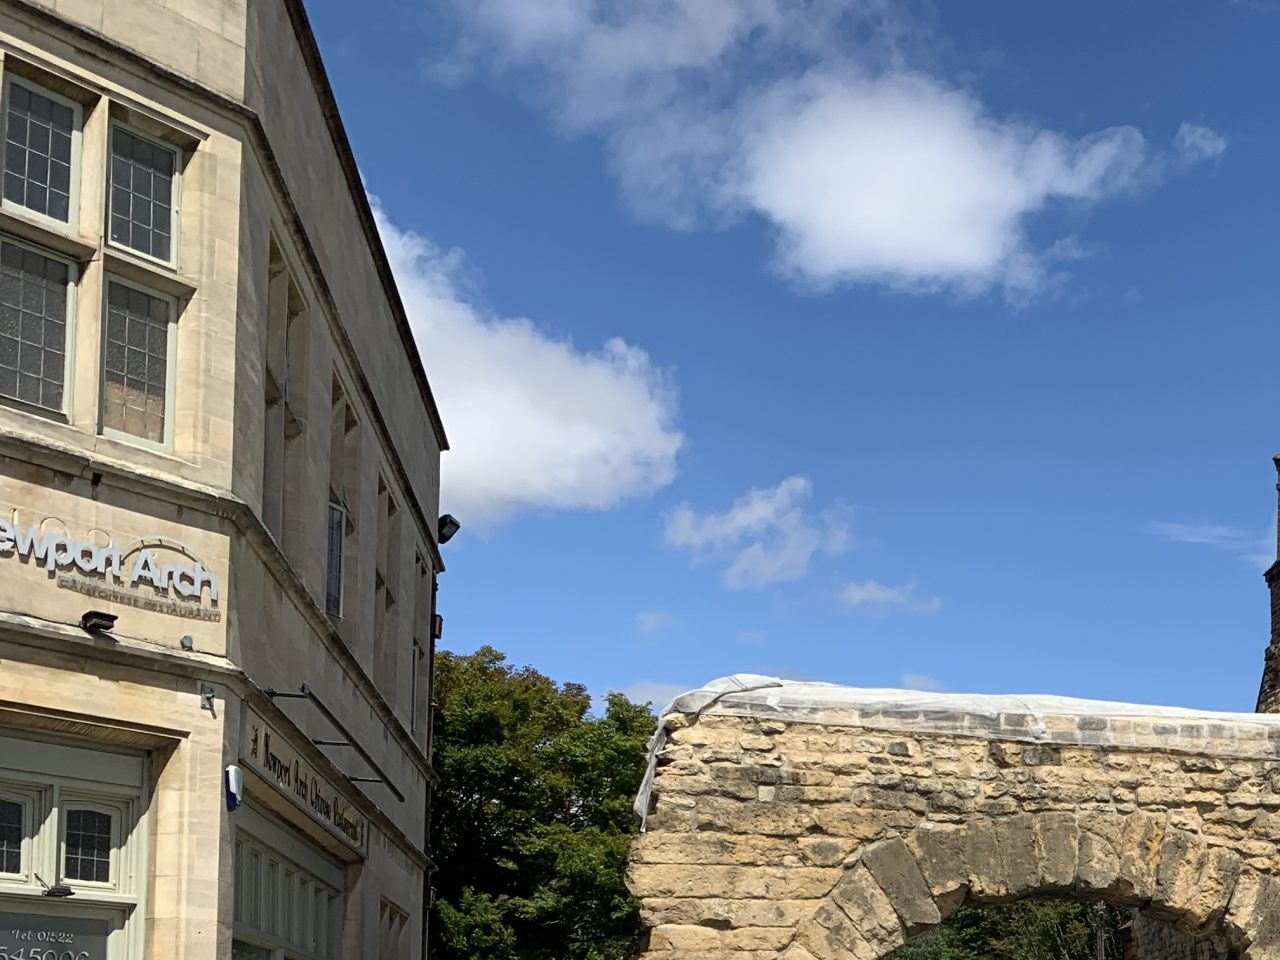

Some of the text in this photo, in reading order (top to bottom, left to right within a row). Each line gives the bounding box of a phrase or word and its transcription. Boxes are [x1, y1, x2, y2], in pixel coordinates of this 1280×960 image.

[131, 549, 218, 600] Arch
[58, 577, 221, 623] CANTONESE RESTAURANT
[263, 732, 359, 842] Newport Arch Chinese Restaurant
[37, 931, 74, 943] 01522
